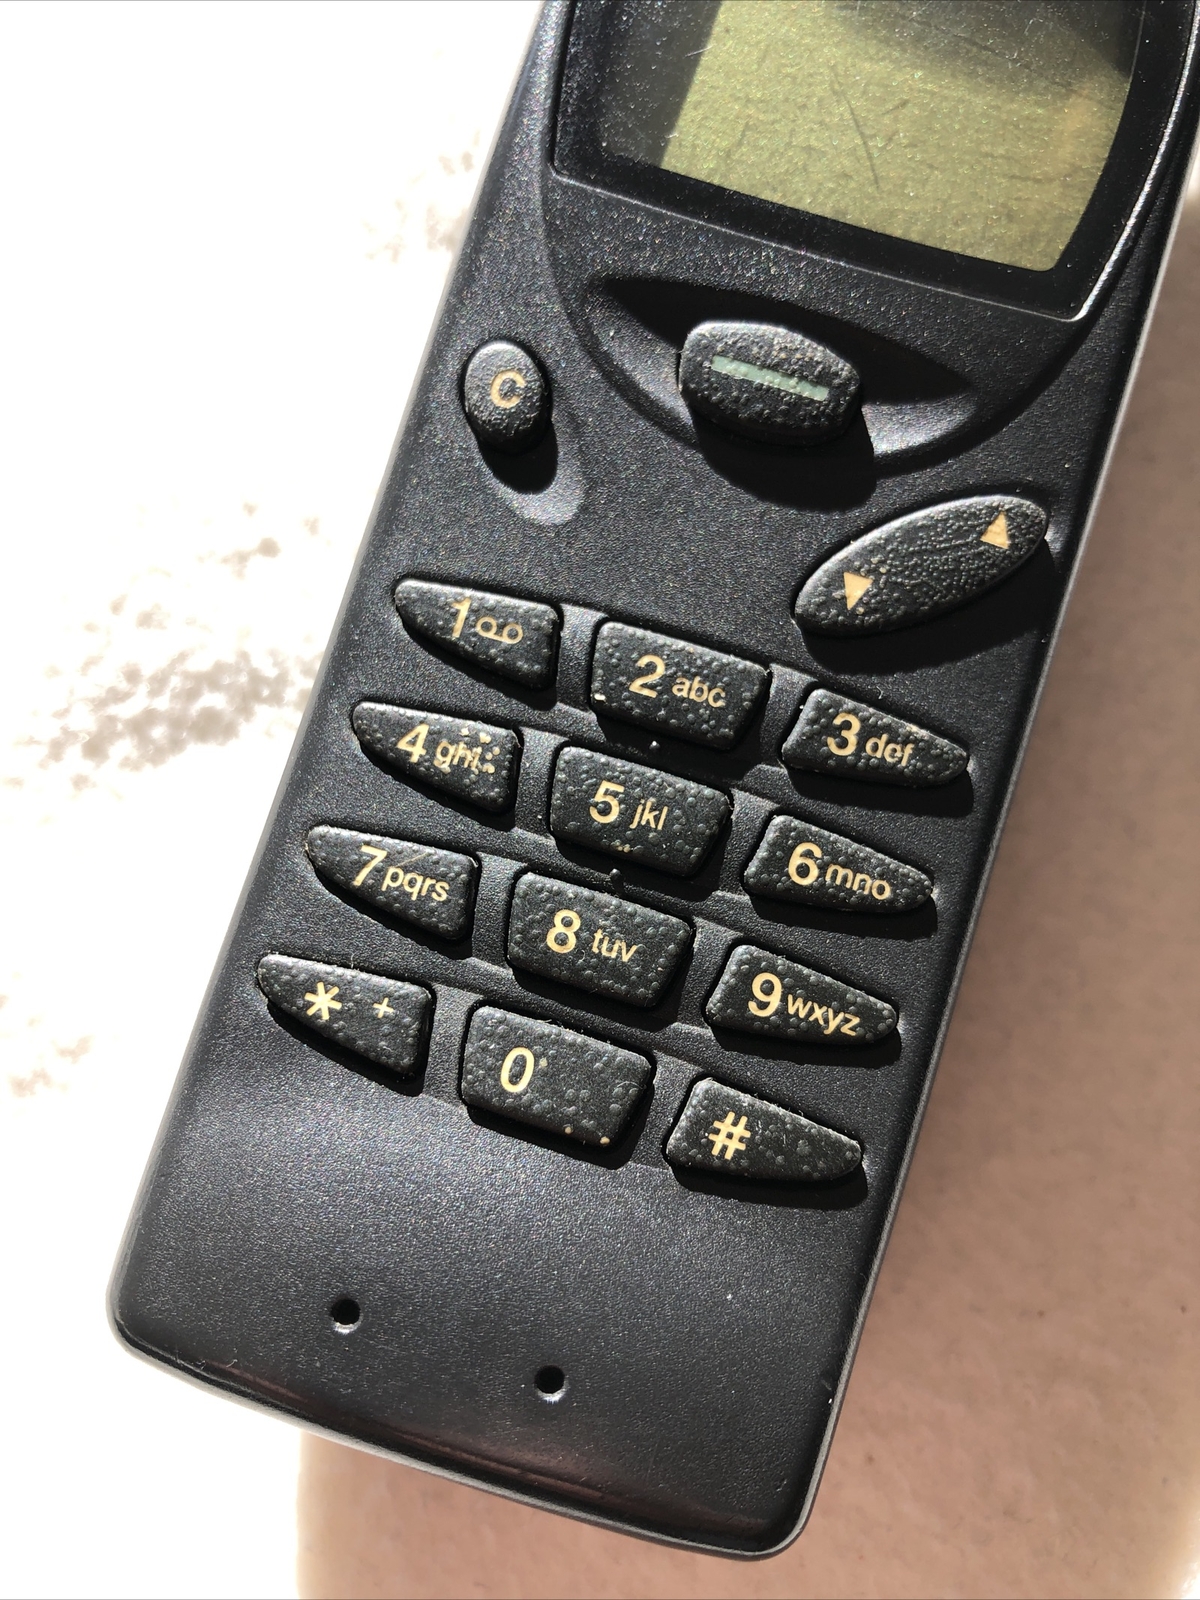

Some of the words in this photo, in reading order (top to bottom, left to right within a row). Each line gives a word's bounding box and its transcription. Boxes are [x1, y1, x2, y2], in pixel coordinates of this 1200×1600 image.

[490, 369, 526, 409] C
[451, 597, 472, 639] 1
[629, 654, 666, 699] 2
[671, 675, 726, 709] abc
[396, 723, 430, 764] 4
[826, 712, 862, 757] 3
[865, 733, 915, 767] def
[589, 779, 625, 824] 5
[629, 799, 669, 831] jkl
[352, 844, 388, 887] 7
[381, 867, 451, 902] pqrs
[787, 841, 823, 886] 6
[824, 863, 892, 901] mno
[545, 908, 581, 955] 8
[590, 927, 638, 964] tuv
[747, 972, 783, 1018] 9
[786, 993, 862, 1037] wxyz
